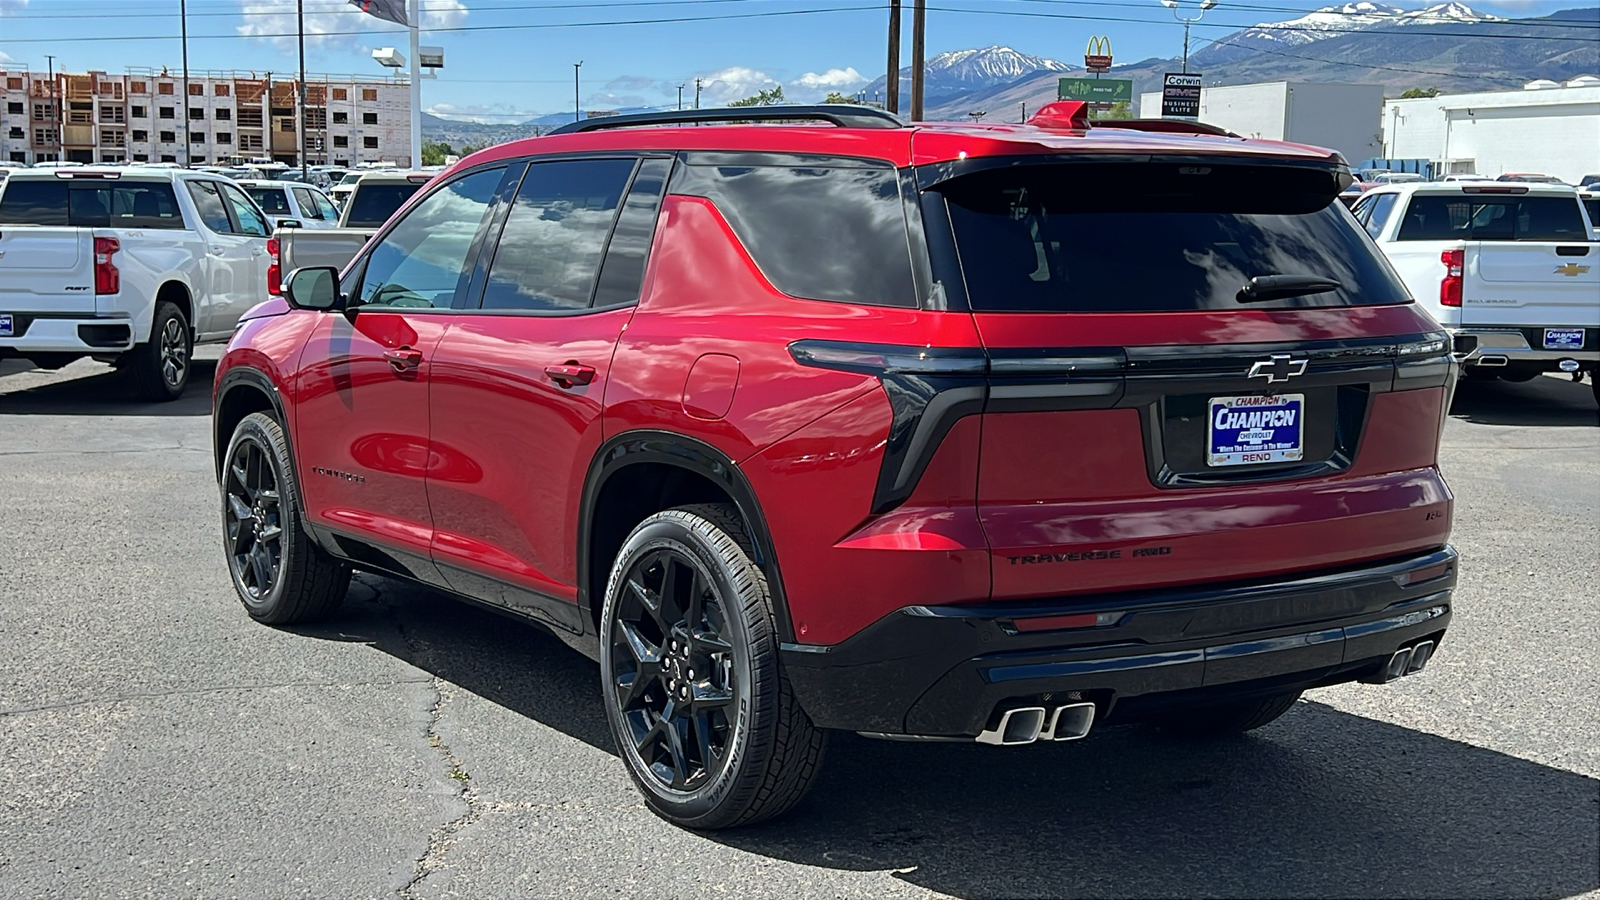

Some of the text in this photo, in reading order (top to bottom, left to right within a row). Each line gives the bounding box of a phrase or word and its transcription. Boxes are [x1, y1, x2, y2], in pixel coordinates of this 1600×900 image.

[1168, 76, 1201, 85] Corwin
[1165, 88, 1199, 96] GMC
[1547, 331, 1581, 339] CHAMPION
[1235, 396, 1280, 406] CHAMPION
[1215, 408, 1296, 430] CHAMPION
[1240, 431, 1272, 439] CHEVROLET
[1242, 453, 1271, 462] RENO
[1007, 547, 1172, 565] TRAVERSE AWD
[706, 698, 747, 803] CONTINENTAL
